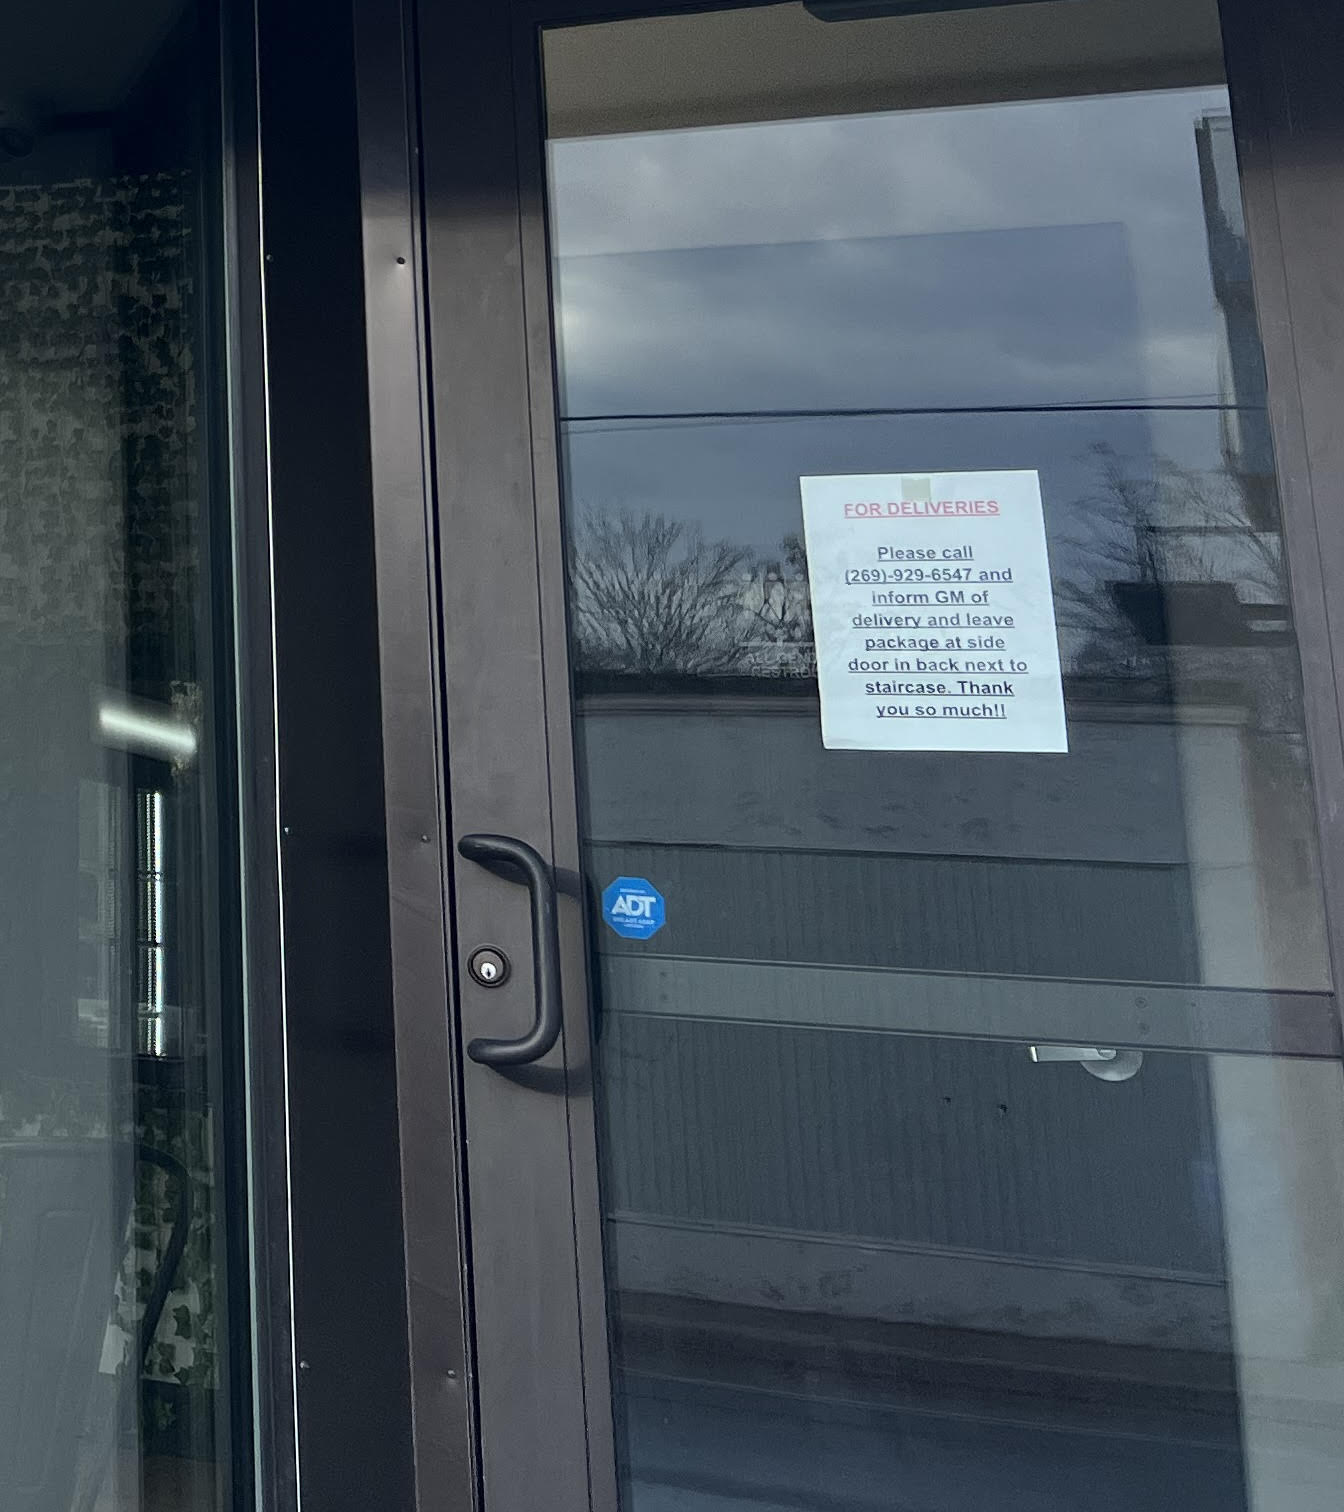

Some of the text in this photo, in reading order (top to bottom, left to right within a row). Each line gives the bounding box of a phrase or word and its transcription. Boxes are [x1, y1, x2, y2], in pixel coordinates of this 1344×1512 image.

[844, 500, 1000, 517] FOR DELIVERIES
[877, 545, 974, 560] Please call
[844, 568, 1013, 584] (269)-929-6547 and
[871, 590, 990, 605] inform GM of
[852, 613, 1014, 629] delivery and leave
[865, 635, 1005, 651] package at side
[848, 658, 1028, 672] door in back next to
[865, 680, 1015, 695] staircase. Thank
[876, 703, 1006, 718] you so much!!
[612, 895, 656, 918] ADT
